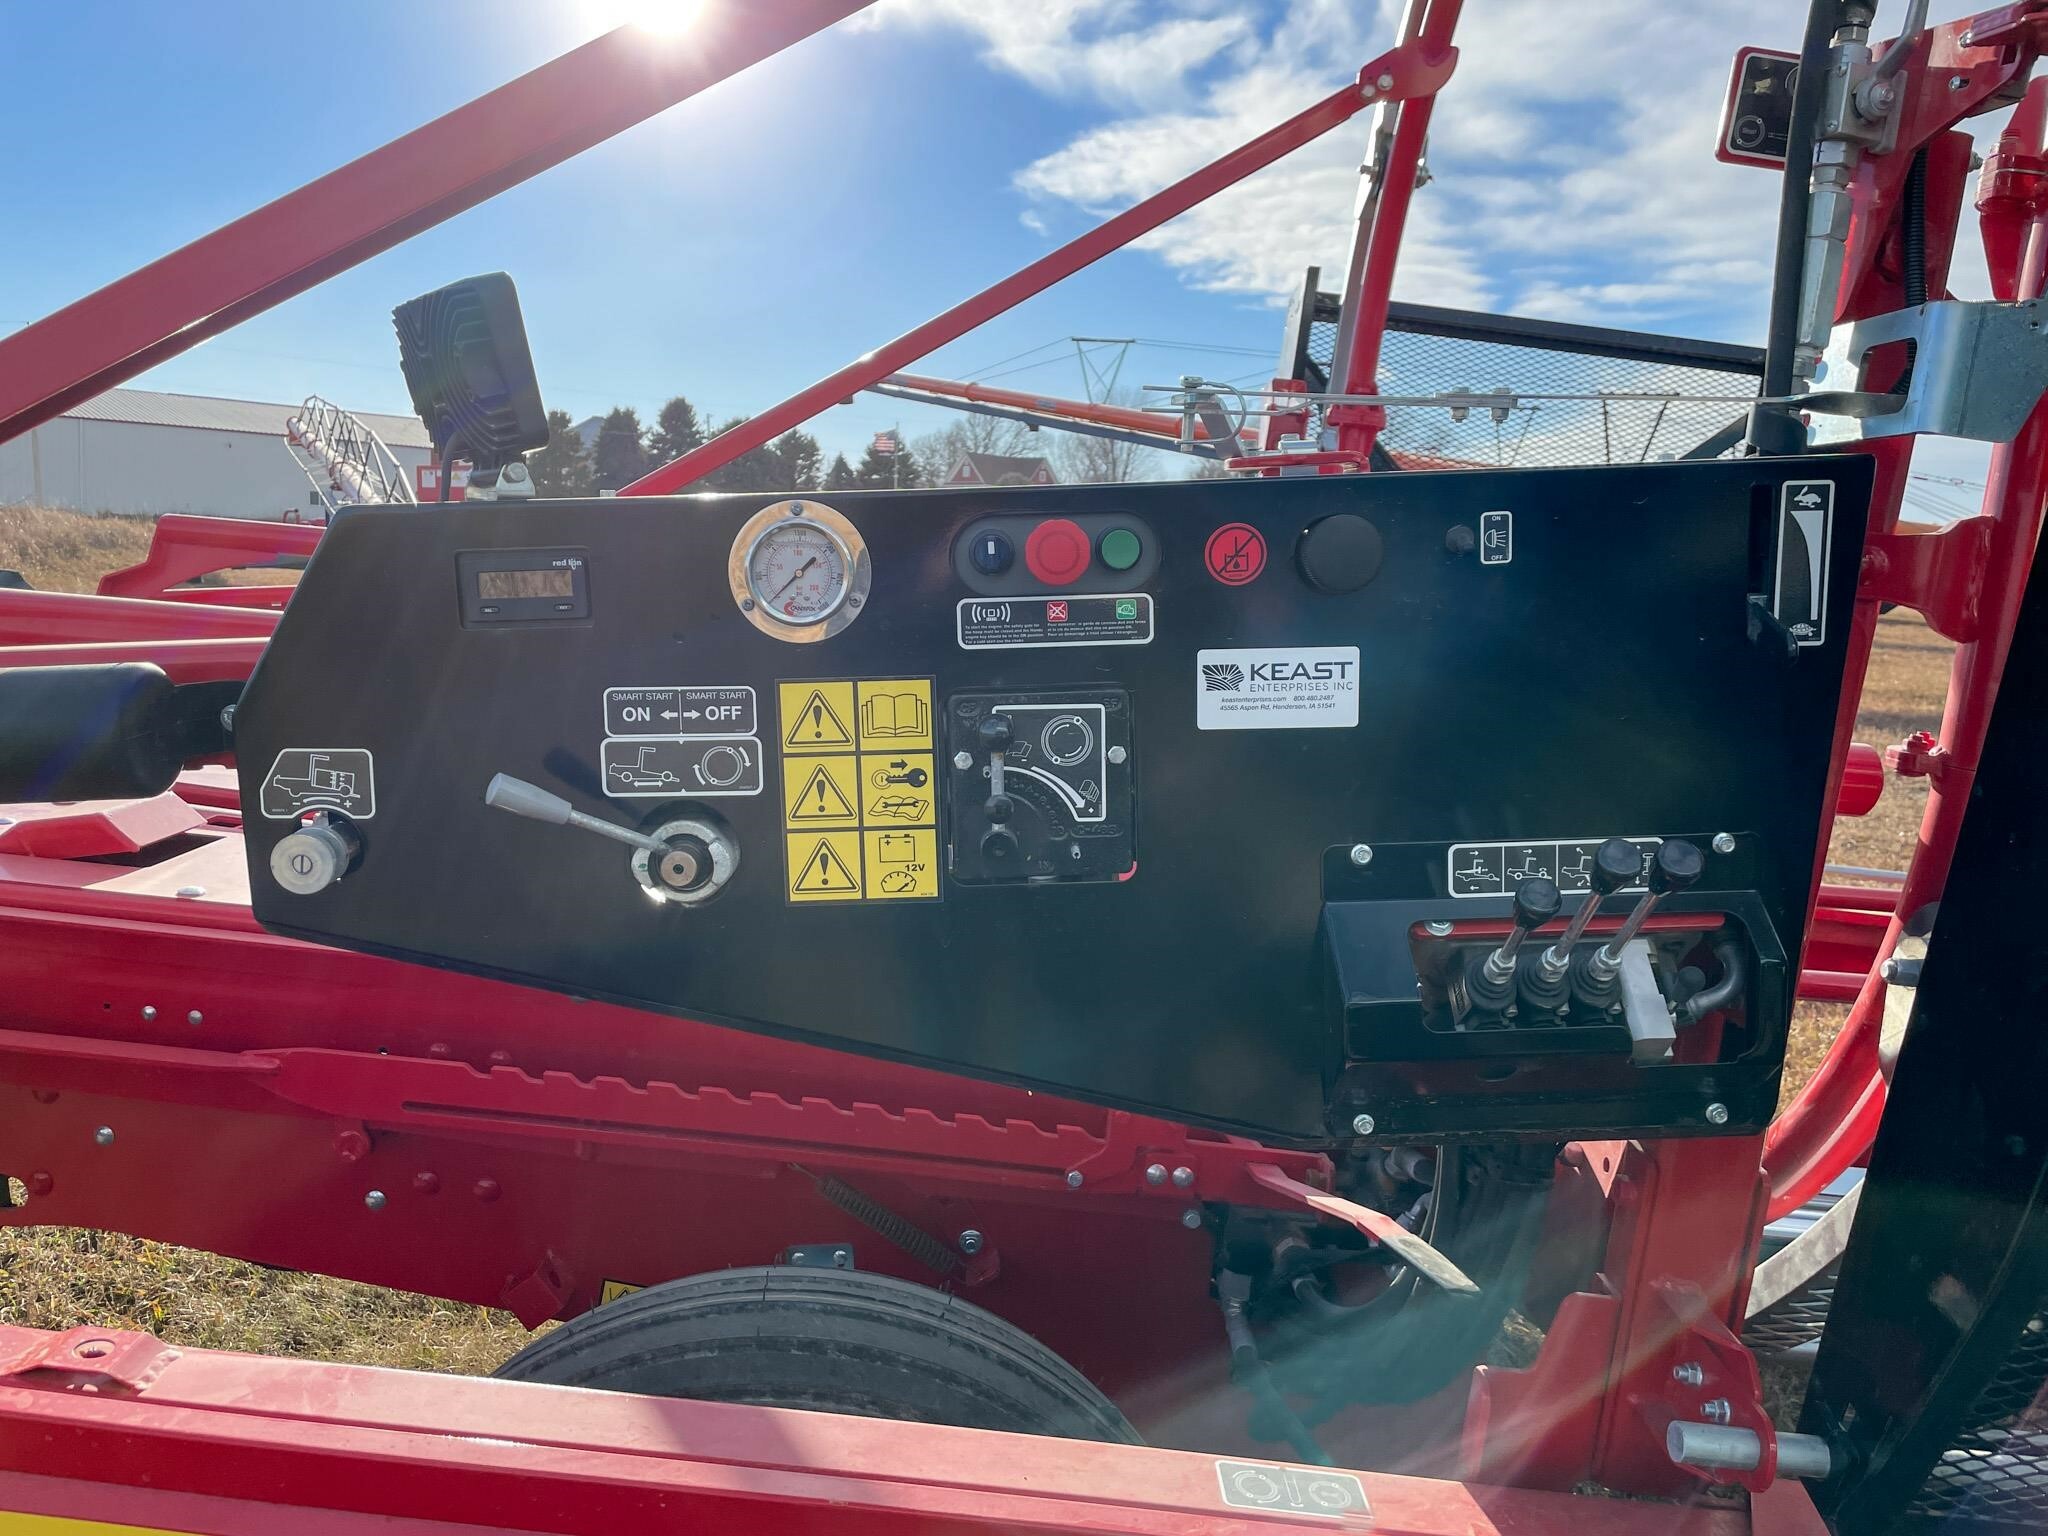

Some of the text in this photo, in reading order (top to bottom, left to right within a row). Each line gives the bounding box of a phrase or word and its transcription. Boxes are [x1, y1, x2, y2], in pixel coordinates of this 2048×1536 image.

[1250, 661, 1353, 681] KEAST
[1250, 681, 1353, 693] ENTERPRISES INC
[612, 692, 673, 701] SMART START
[686, 691, 747, 700] SMART START
[1221, 695, 1287, 704] keastenterprises.com
[705, 705, 742, 720] OFF
[1240, 704, 1259, 712] Aspen
[622, 706, 650, 722] ON
[905, 863, 925, 871] 12V
